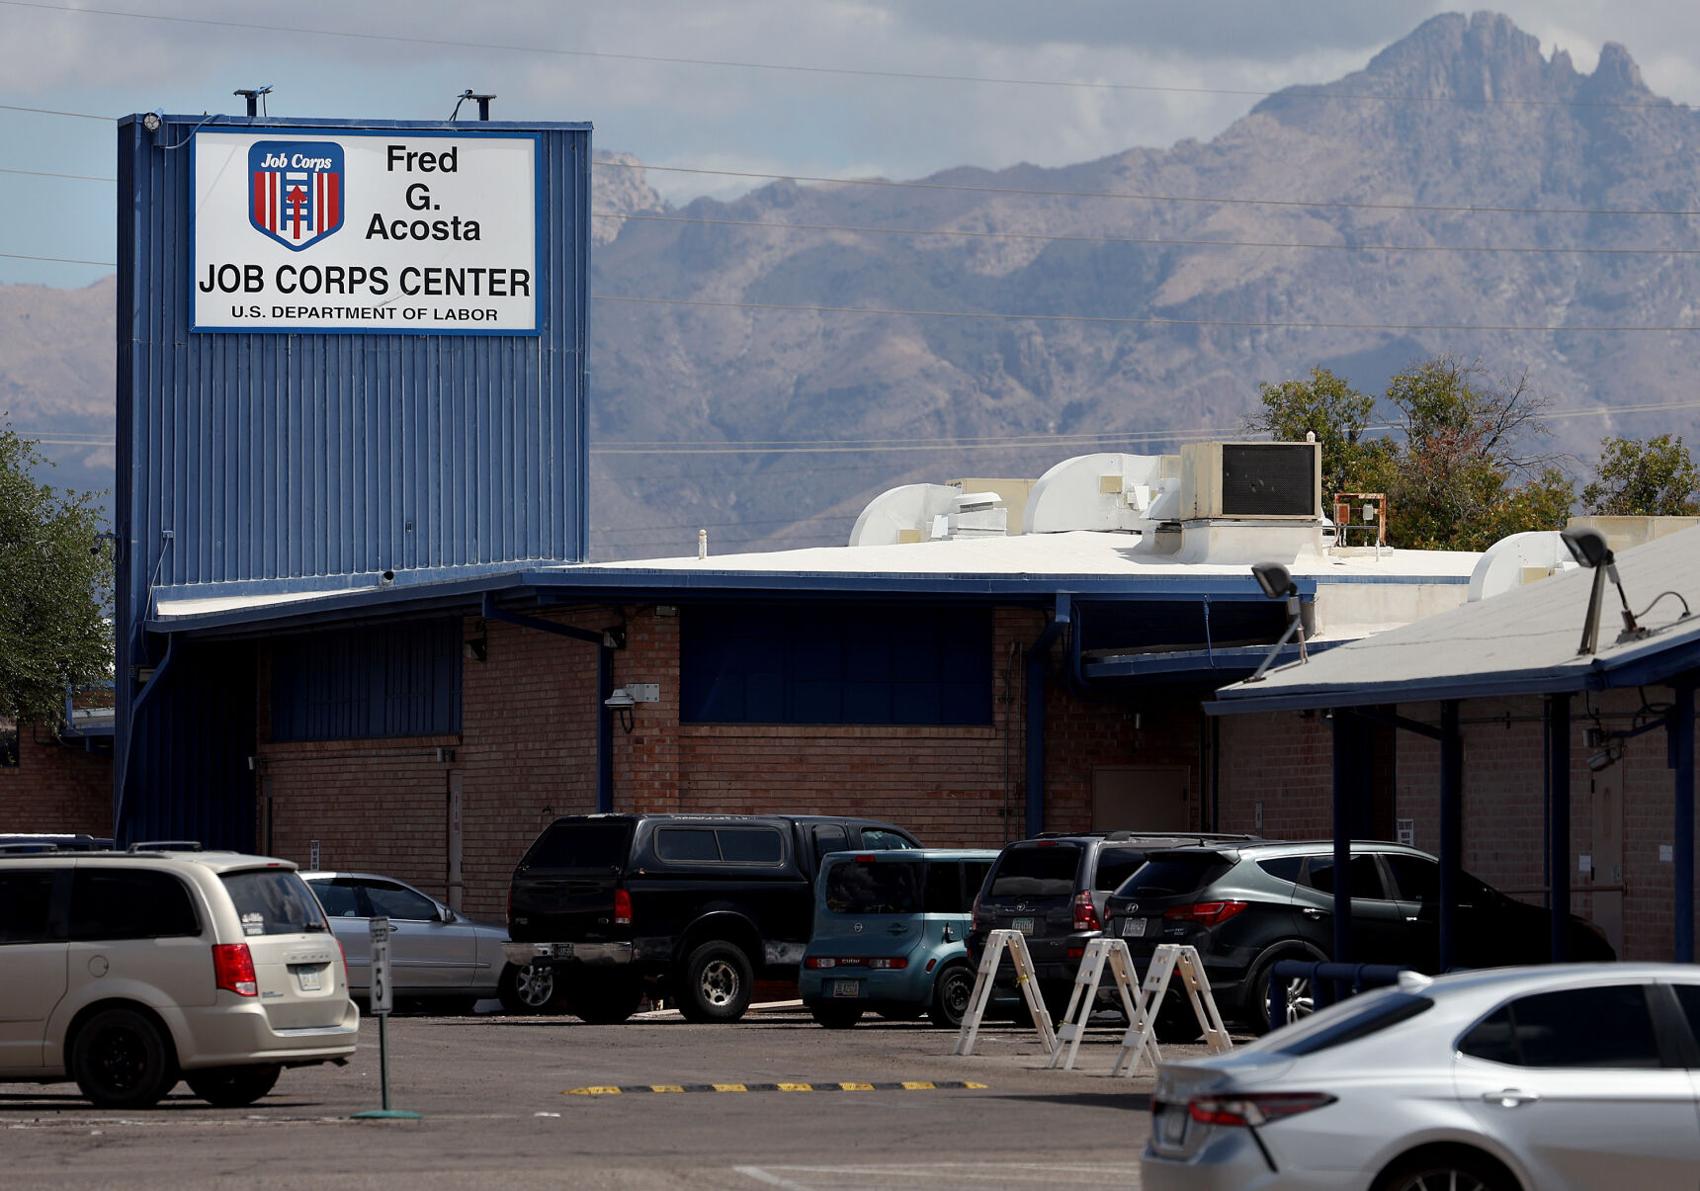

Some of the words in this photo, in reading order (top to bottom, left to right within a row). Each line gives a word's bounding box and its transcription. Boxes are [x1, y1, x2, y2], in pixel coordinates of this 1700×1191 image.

[260, 152, 288, 168] Job
[291, 153, 333, 173] Corps
[387, 144, 458, 173] Fred
[405, 182, 441, 211] G.
[365, 213, 481, 242] Acosta
[198, 263, 265, 294] JOB
[275, 264, 389, 296] CORPS
[399, 266, 531, 297] CENTER
[231, 305, 266, 318] U.S.
[271, 306, 397, 320] DEPARTMENT
[402, 307, 428, 320] OF
[433, 308, 498, 321] LABOR
